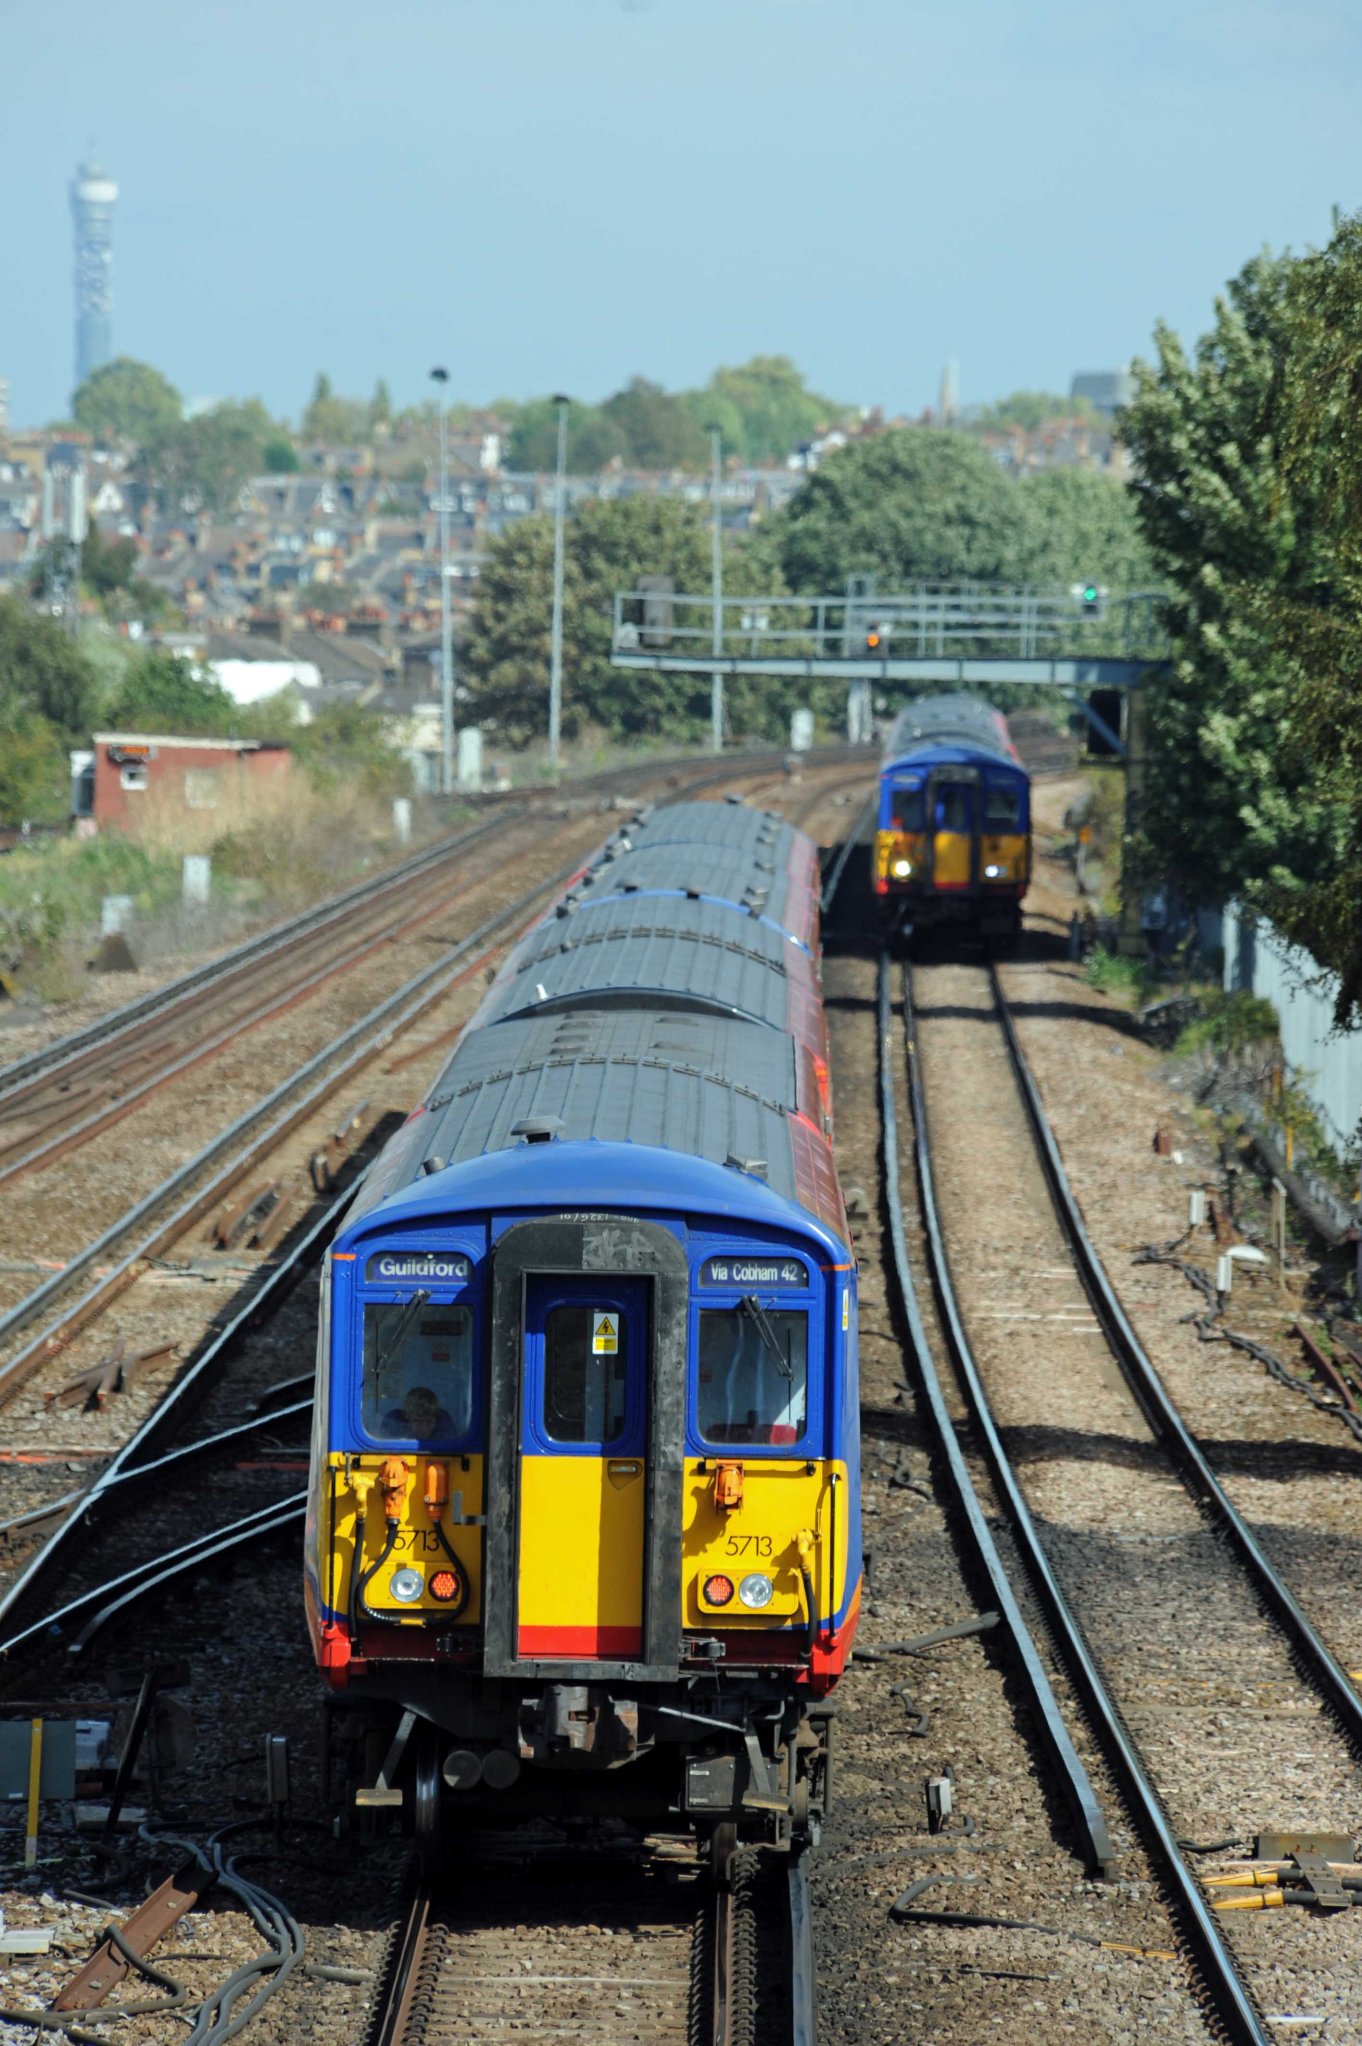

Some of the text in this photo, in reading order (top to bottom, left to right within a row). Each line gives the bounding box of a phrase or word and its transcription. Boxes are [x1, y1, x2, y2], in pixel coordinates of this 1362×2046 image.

[380, 1258, 468, 1277] Guildford
[711, 1263, 798, 1281] Via Cobham 42
[725, 1535, 773, 1557] 5713
